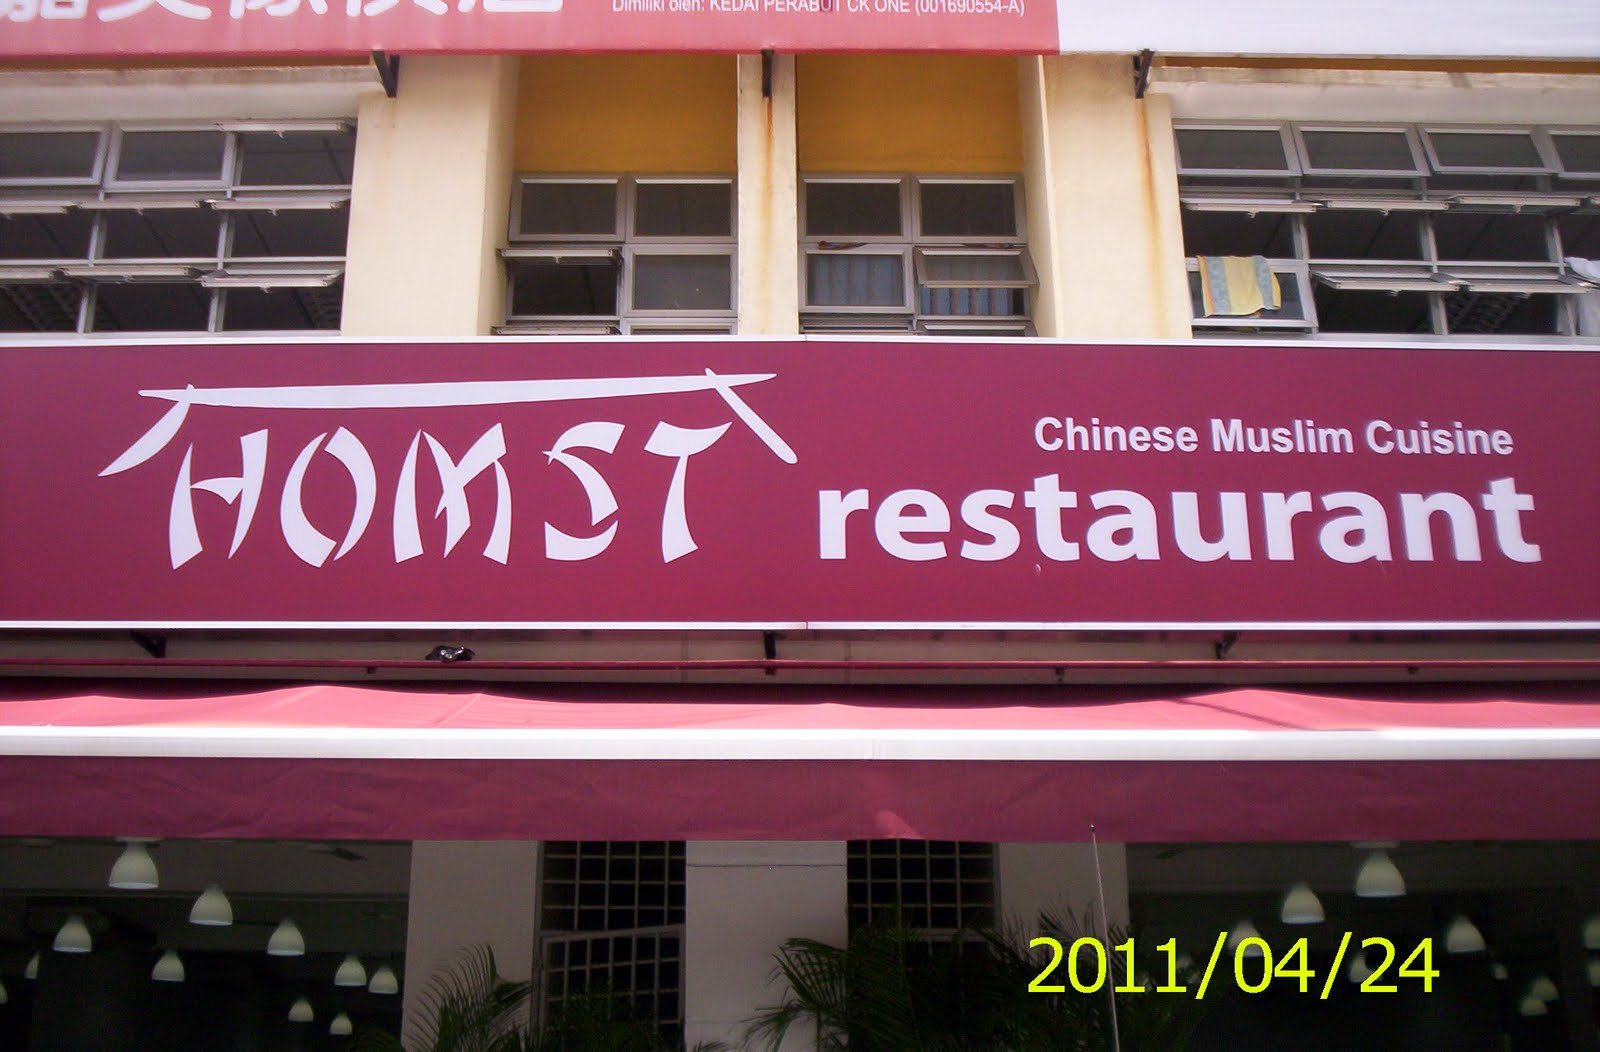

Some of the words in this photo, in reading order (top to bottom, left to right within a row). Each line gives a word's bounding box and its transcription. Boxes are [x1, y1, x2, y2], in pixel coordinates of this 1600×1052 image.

[710, 0, 759, 12] KEDAI
[847, 0, 870, 13] CK
[874, 0, 910, 13] ONE
[1035, 417, 1198, 452] Chinese
[1211, 418, 1354, 453] Muslim
[1366, 420, 1513, 455] Cuisine
[168, 421, 733, 569] HOMST
[819, 473, 1541, 563] restaurant
